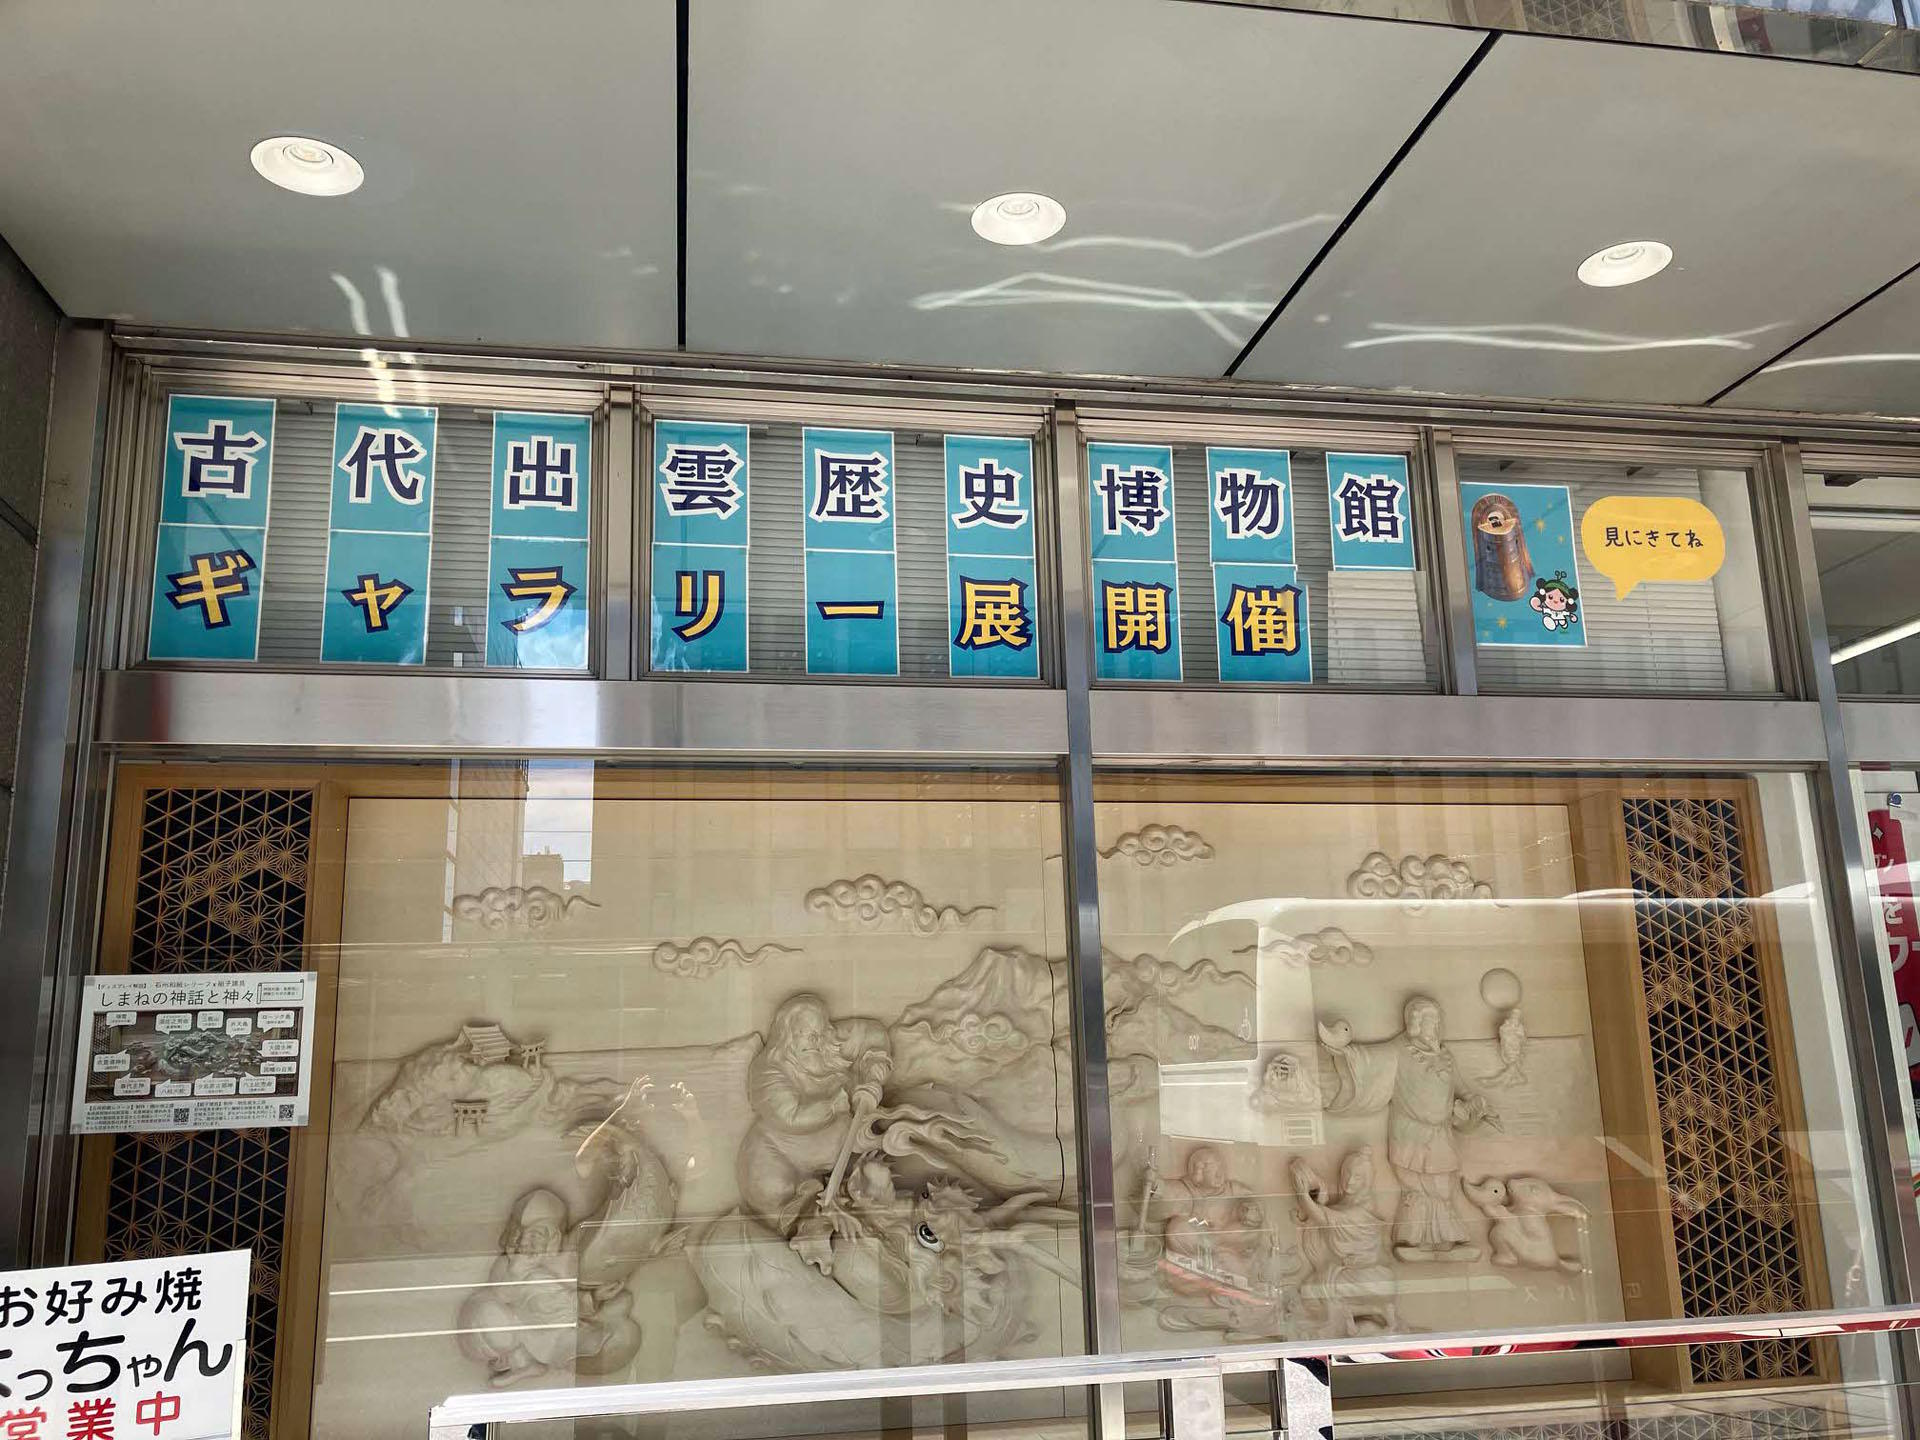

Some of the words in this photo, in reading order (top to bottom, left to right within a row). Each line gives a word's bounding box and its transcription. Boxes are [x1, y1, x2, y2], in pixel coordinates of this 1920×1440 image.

[174, 419, 1406, 543] 古代出雲歴史博物館
[1604, 526, 1704, 549] 見にきてね
[165, 549, 1302, 656] ギャラリー展開催
[101, 989, 254, 1007] しまねの神話と神々
[0, 1267, 202, 1328] お好み焼
[0, 1391, 181, 1440] 営業中
